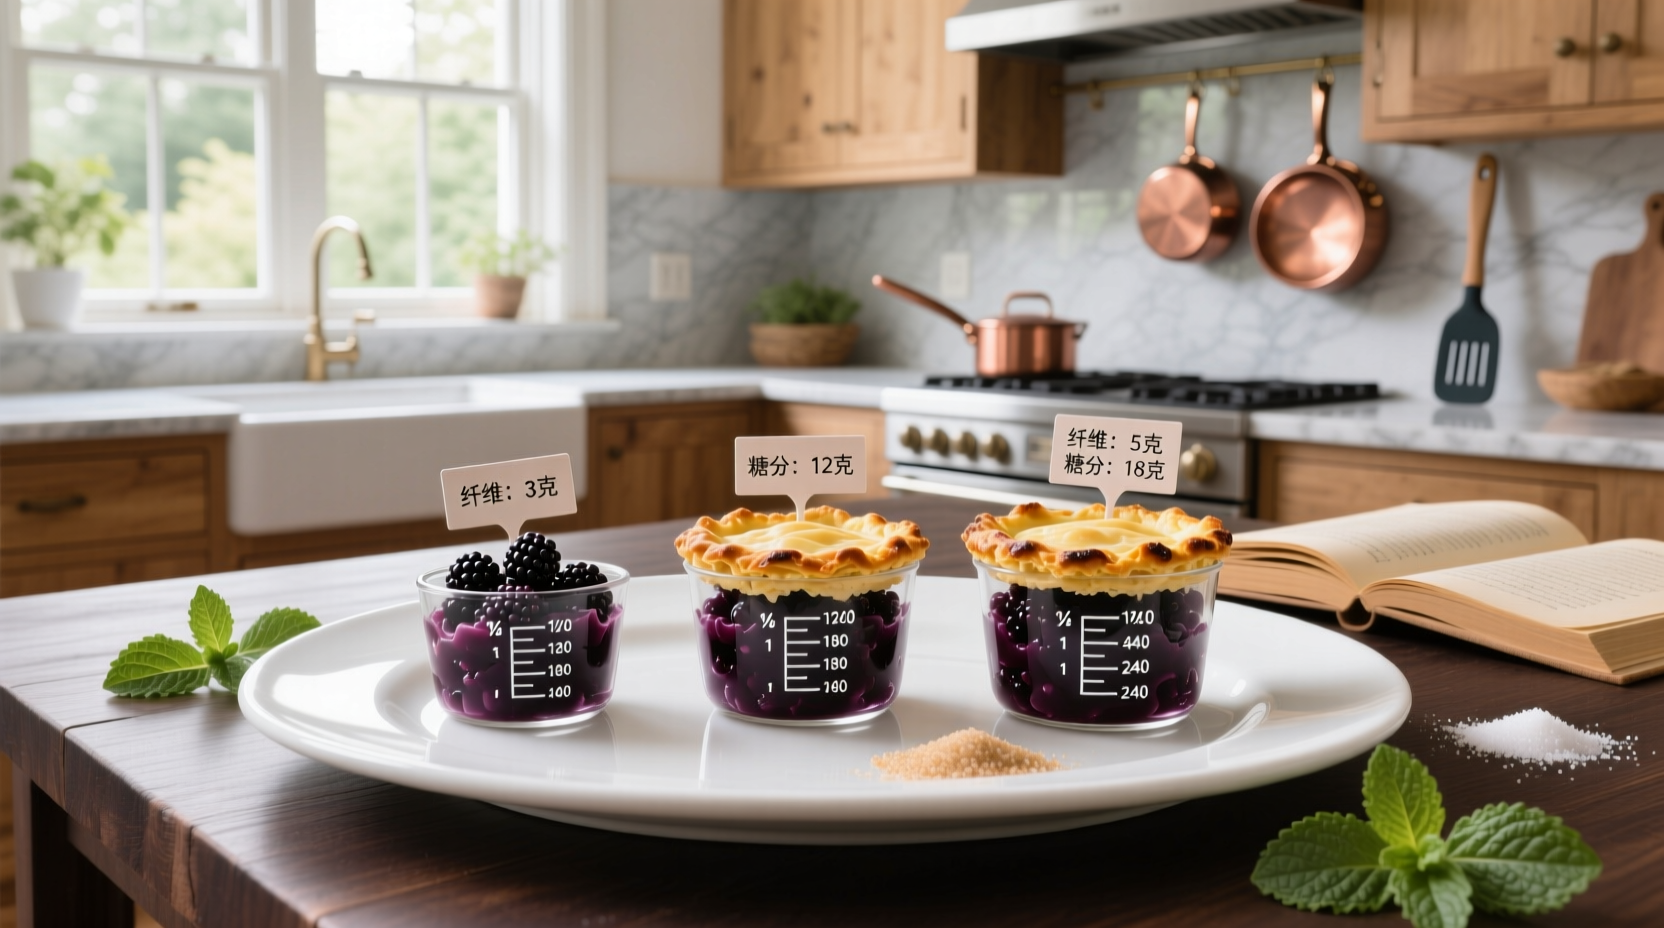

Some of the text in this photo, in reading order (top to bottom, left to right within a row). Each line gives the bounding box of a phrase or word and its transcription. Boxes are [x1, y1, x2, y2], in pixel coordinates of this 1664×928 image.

[1067, 427, 1163, 455] 纤维：5克
[747, 453, 854, 478] 糖分：12克
[1063, 452, 1166, 481] 糖分：18克
[460, 475, 559, 508] 纤维：3克
[1059, 636, 1067, 650] 1
[1060, 662, 1066, 676] 1
[1121, 659, 1150, 675] 240
[1120, 684, 1149, 700] 240
